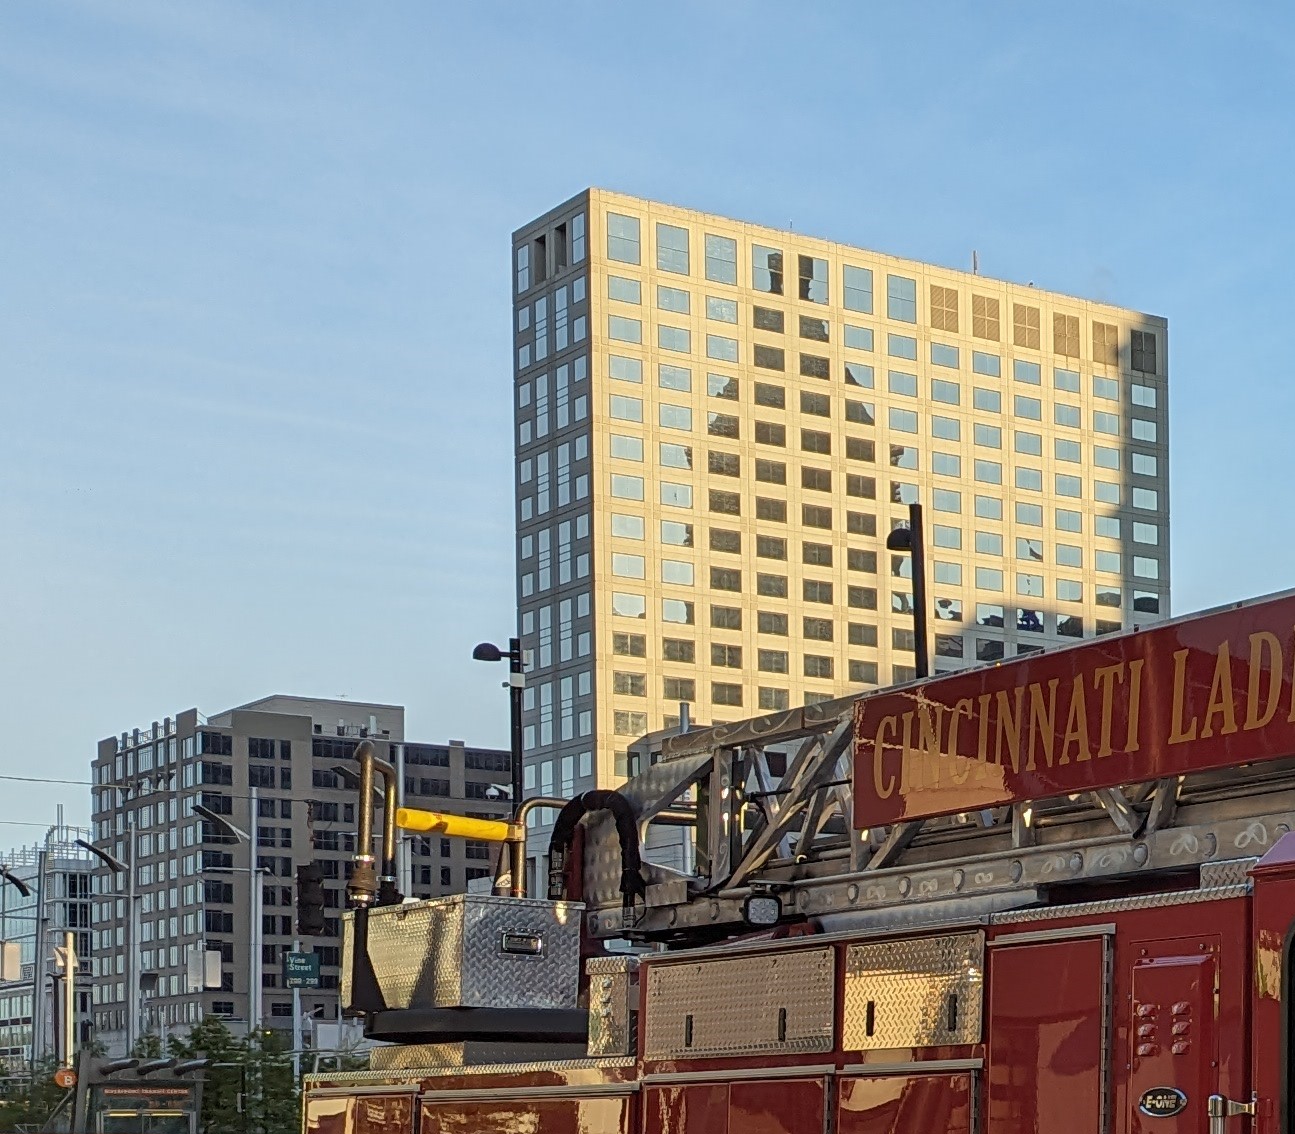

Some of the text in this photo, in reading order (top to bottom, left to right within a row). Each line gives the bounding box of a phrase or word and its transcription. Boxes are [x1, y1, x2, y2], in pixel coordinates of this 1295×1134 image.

[873, 659, 1144, 800] CINCINNATI
[64, 1075, 72, 1086] B
[1145, 1094, 1178, 1109] E-ONE
